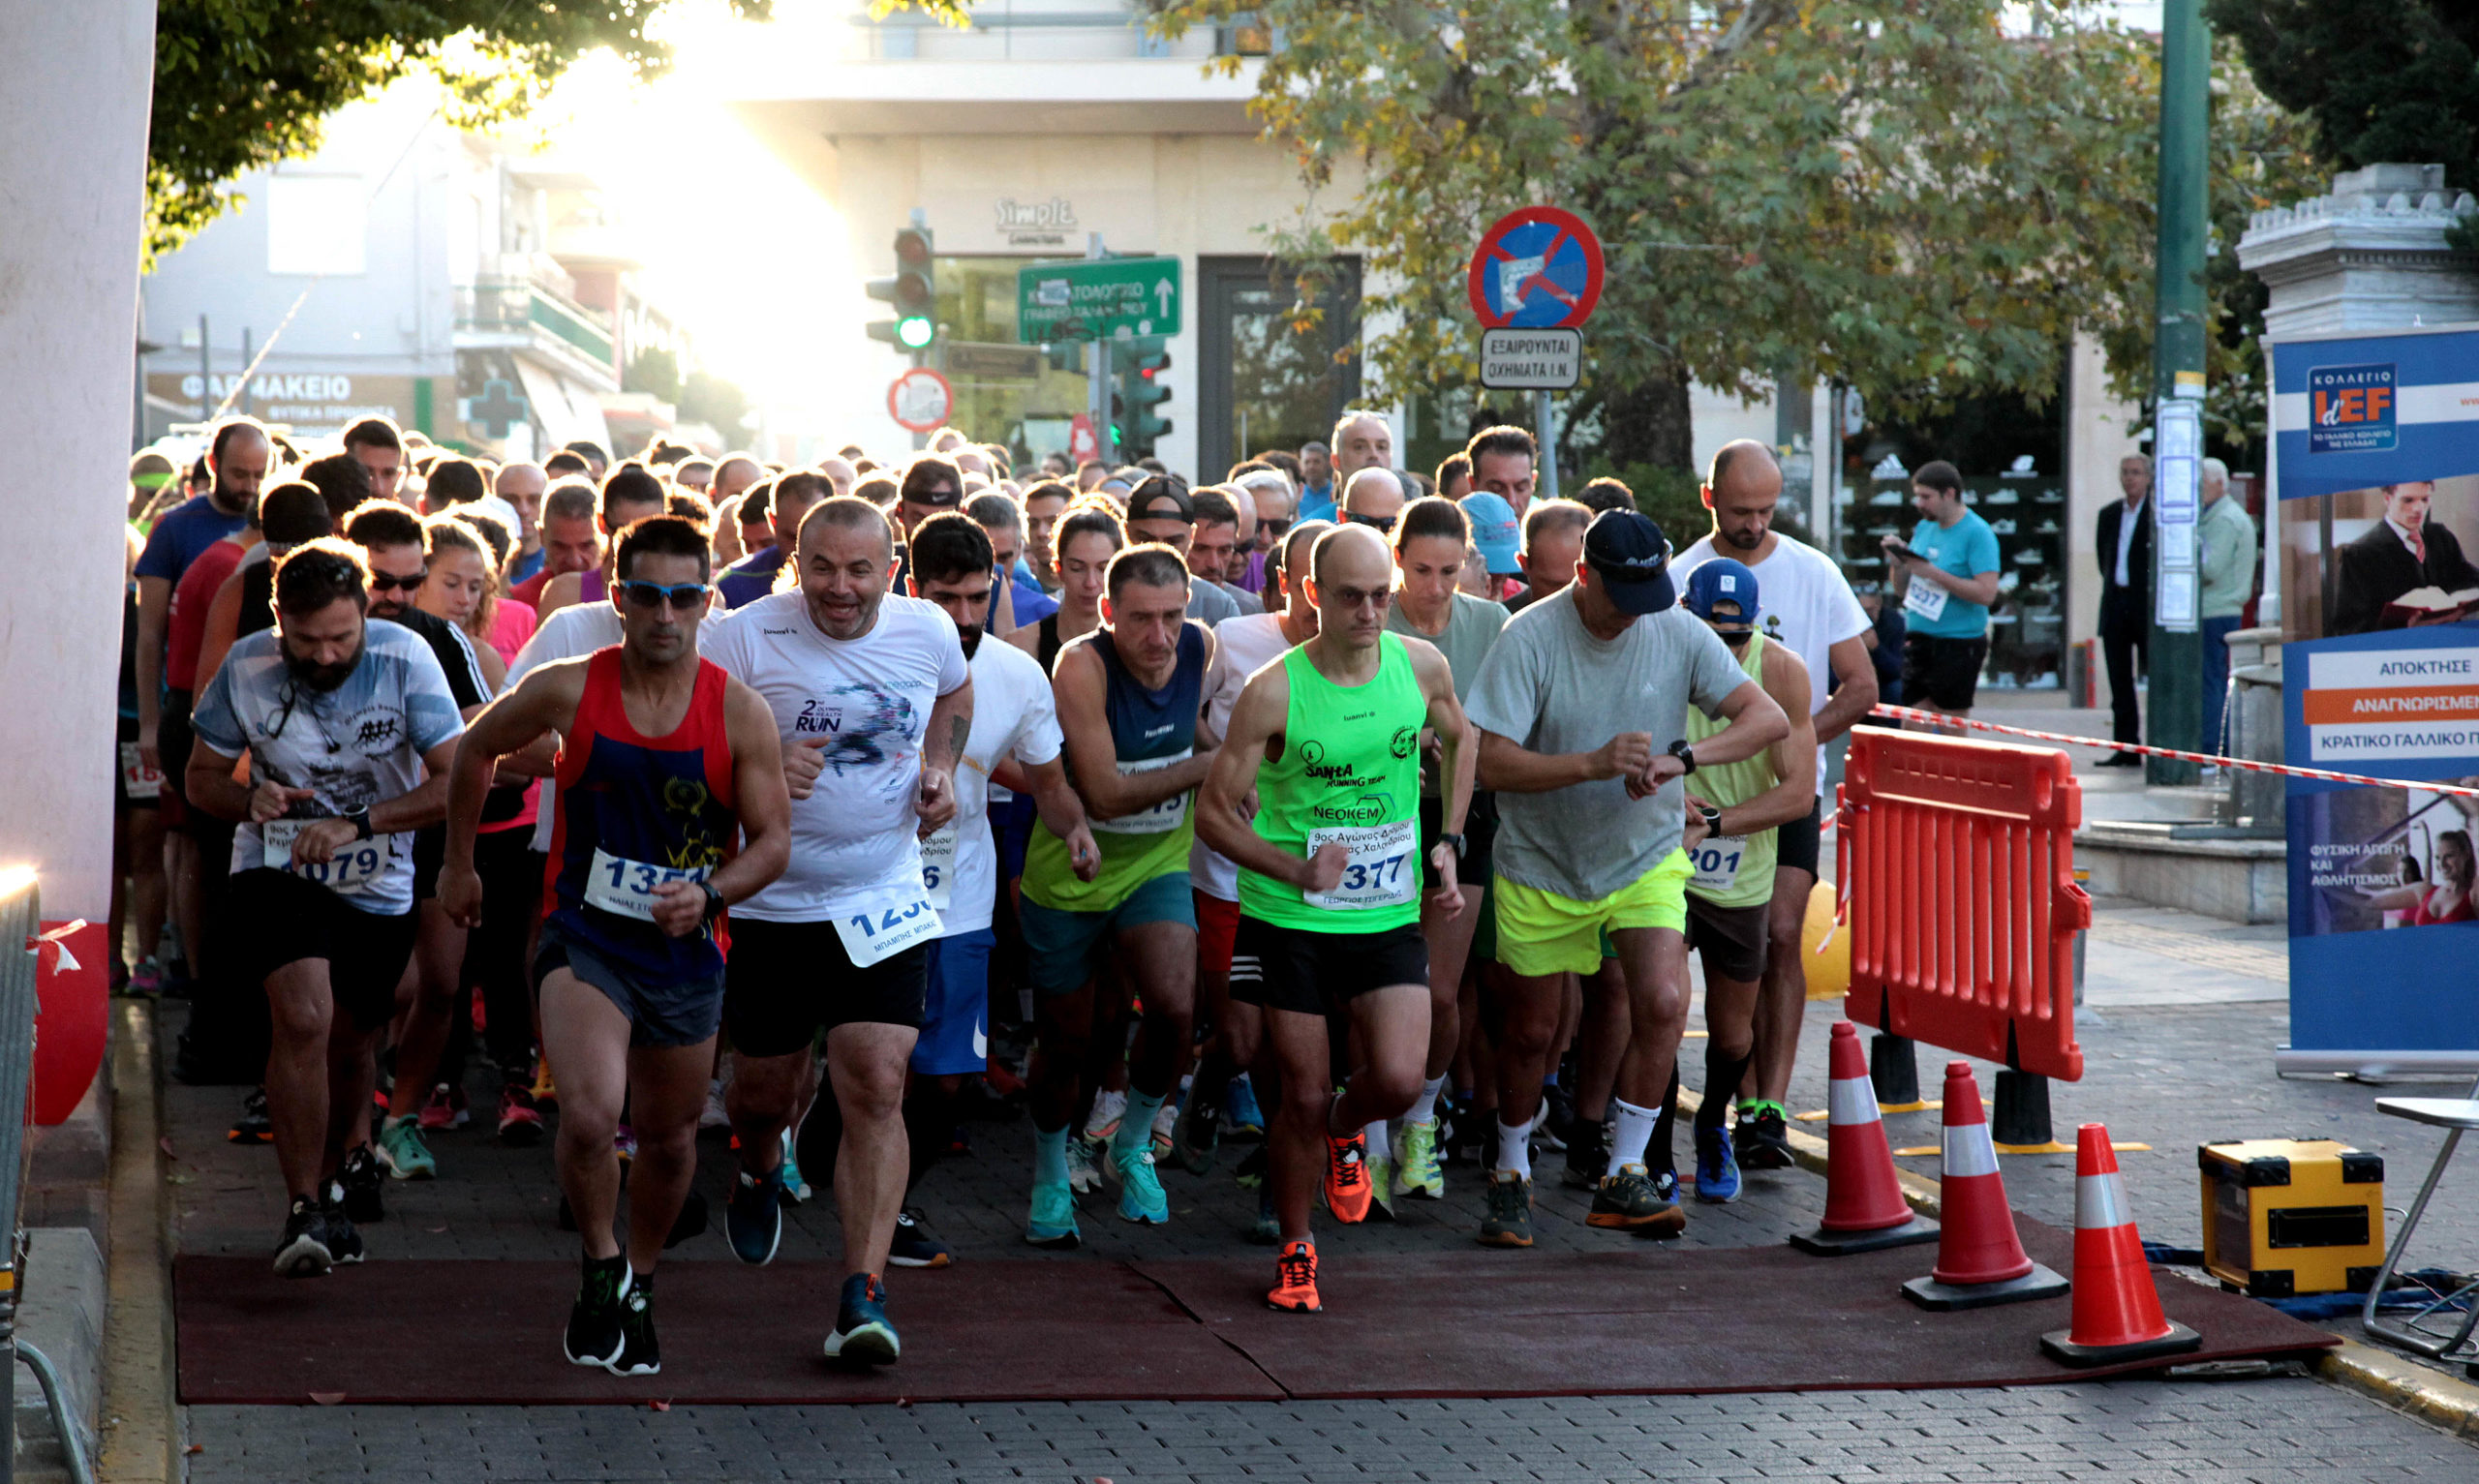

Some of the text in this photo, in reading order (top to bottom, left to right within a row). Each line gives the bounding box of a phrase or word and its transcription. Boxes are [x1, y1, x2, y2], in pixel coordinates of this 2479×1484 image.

[1491, 339, 1571, 354] ΕΞΑΙΡΟΥΝΤΑΙ
[1488, 363, 1546, 378] ΟΧΗΜΑΤΑ
[2314, 372, 2391, 385] ΚΟΛΛΕΓΙΟ
[2380, 659, 2471, 676] ΑΠΟΚΤΗΣΕ
[795, 716, 841, 732] RUN
[2321, 735, 2391, 748] ΚΡΑΤΙΚΟ
[2395, 732, 2465, 746] ΓΑΛΛΙΚΟ
[1325, 776, 1365, 789] RUNNING
[1313, 805, 1379, 821] NEOKEM
[1314, 833, 1333, 843] 9ος
[1336, 832, 1378, 844] Αγώνας
[2311, 844, 2361, 856] ΦΥΣΙΚΗ
[2311, 860, 2333, 871] ΚΑΙ
[2311, 873, 2398, 886] ΑΘΛΗΤΙΣΜΟΣ
[873, 930, 912, 953] ΜΠΑΜΠΗΣ
